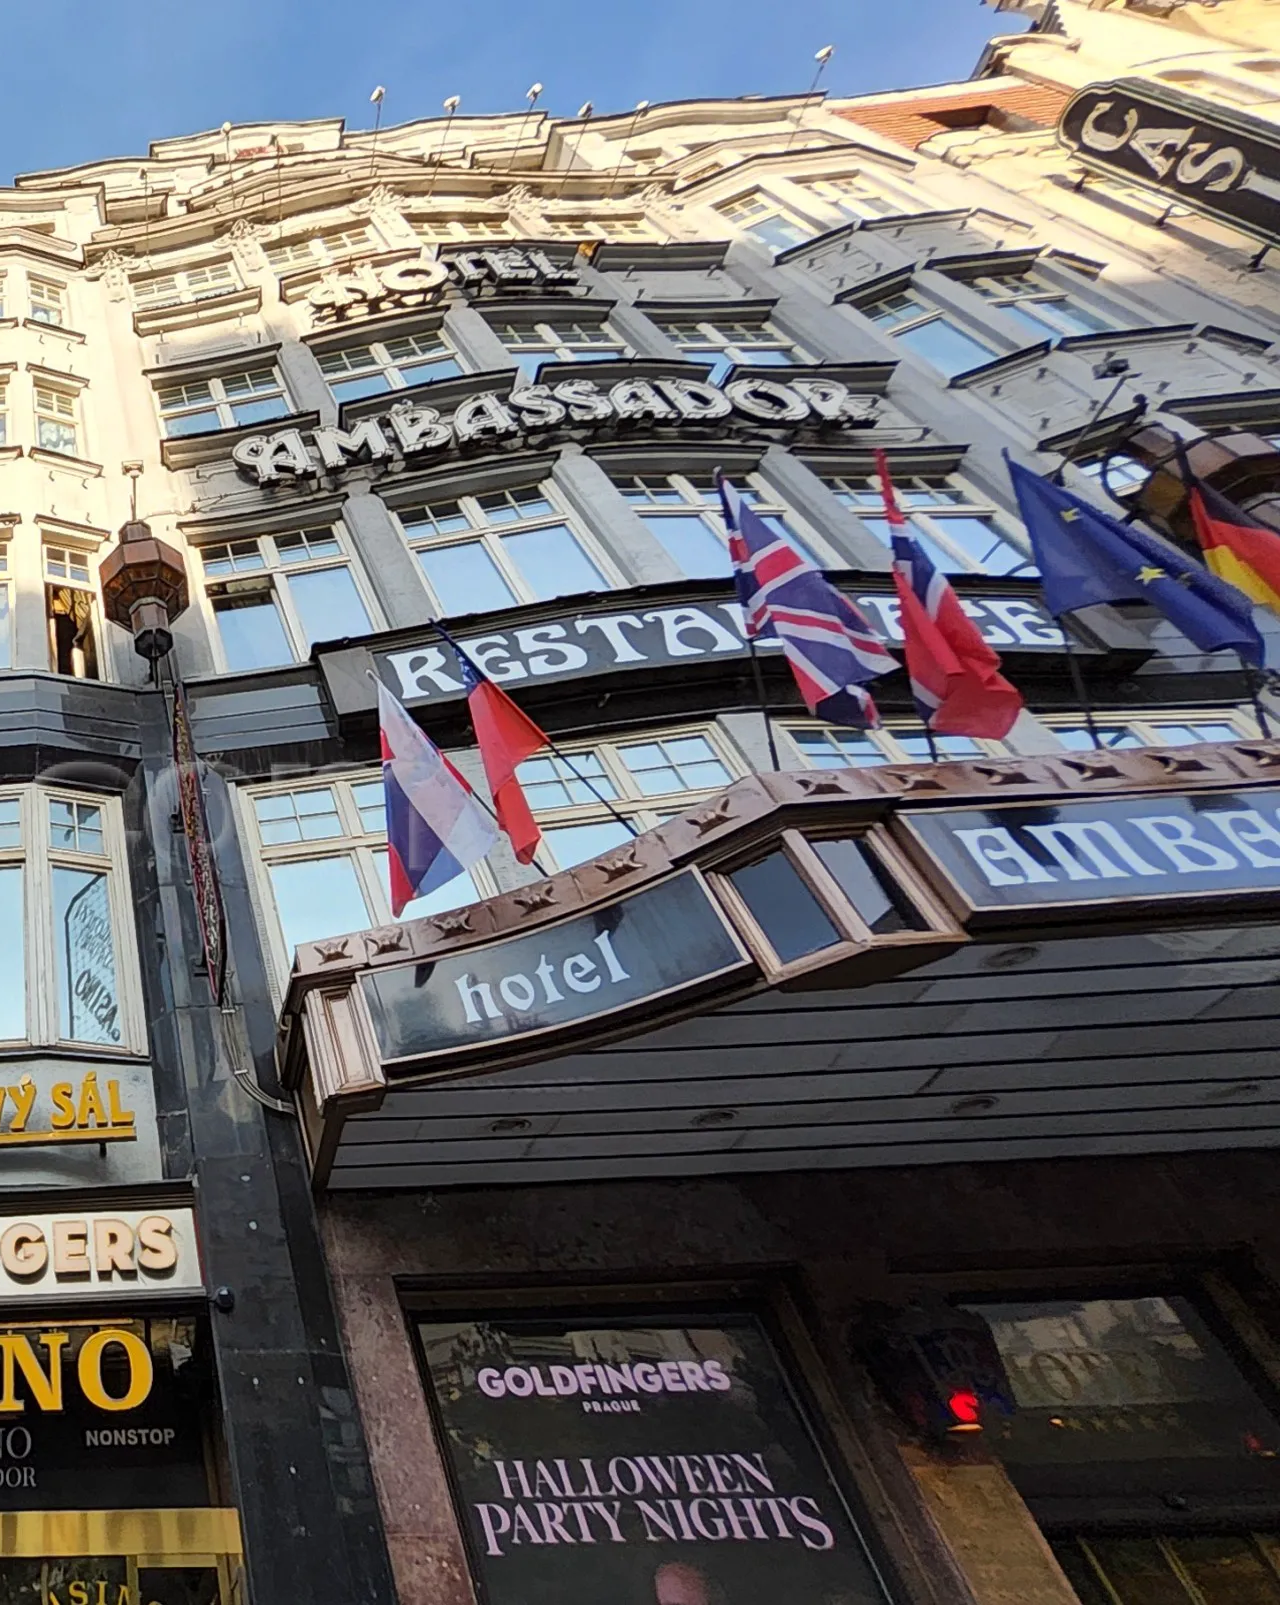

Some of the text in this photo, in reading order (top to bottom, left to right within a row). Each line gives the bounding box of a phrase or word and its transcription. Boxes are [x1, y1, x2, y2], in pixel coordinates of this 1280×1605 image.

[306, 246, 582, 310] HOTEL
[232, 376, 882, 486] AMBASSADOR
[386, 597, 1065, 699] RESTAE
[952, 809, 1280, 886] AMBA
[453, 930, 630, 1023] hotel
[50, 1071, 135, 1129] SÁL
[478, 1359, 731, 1399] GOLDFINGERS
[582, 1399, 641, 1413] PRAGUE
[85, 1428, 175, 1448] NONSTOP
[494, 1453, 775, 1499] HALLOWEEN
[474, 1496, 835, 1556] PARTY NIGHTS
